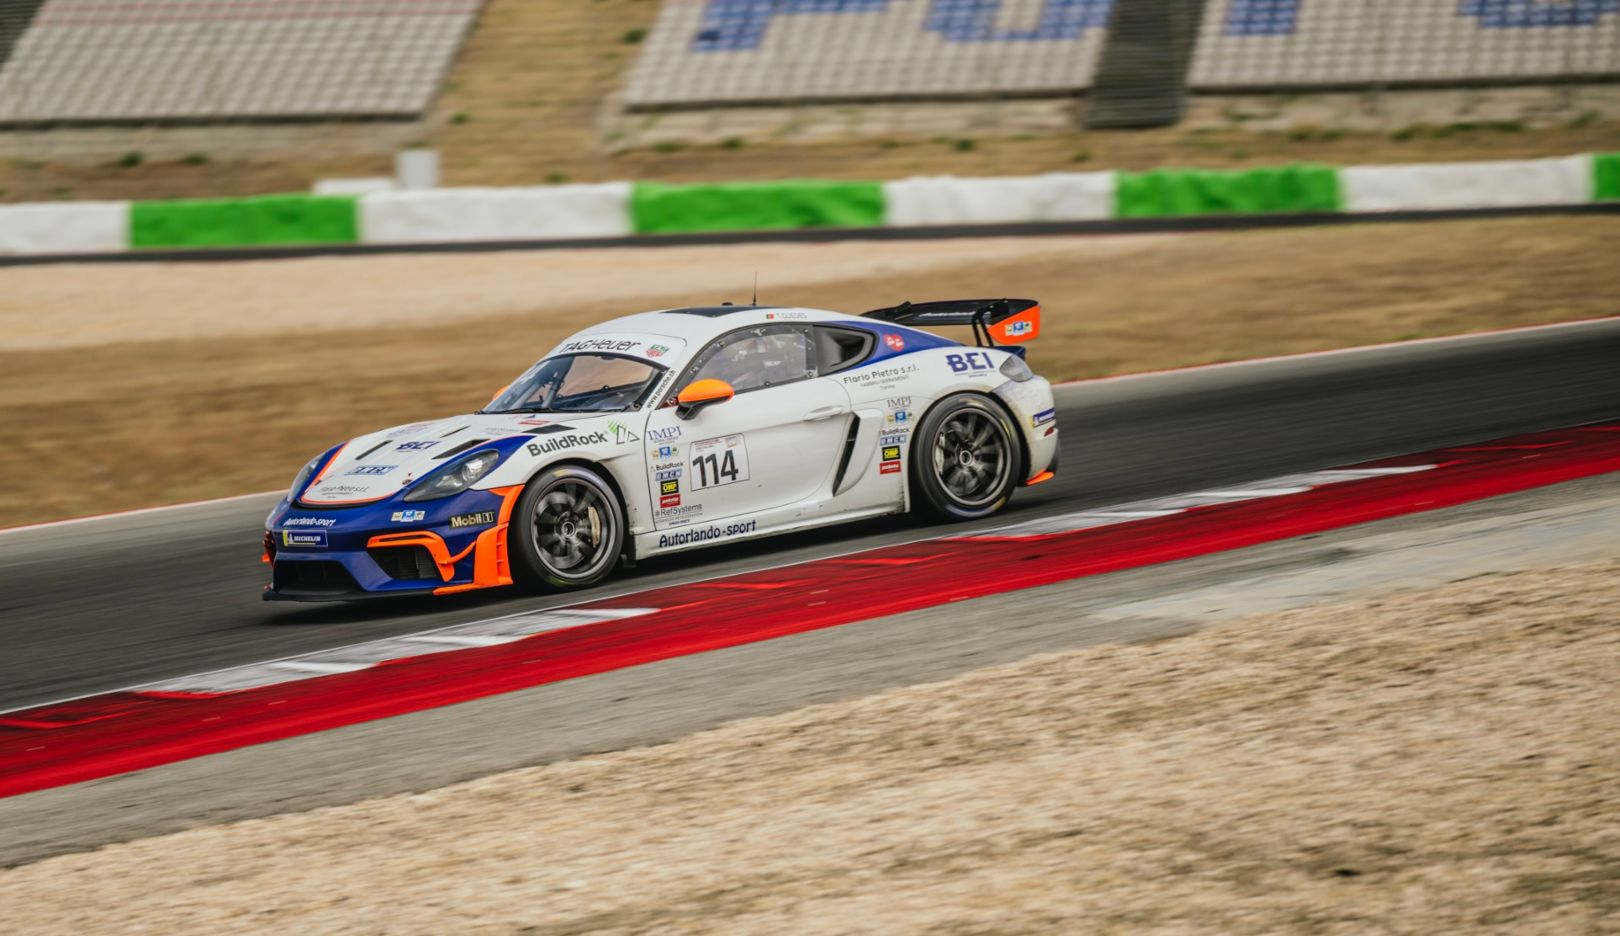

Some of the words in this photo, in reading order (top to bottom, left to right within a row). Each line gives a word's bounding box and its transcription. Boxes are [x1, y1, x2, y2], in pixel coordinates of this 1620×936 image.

[946, 352, 995, 373] BEI
[872, 368, 899, 378] Pietro
[887, 396, 911, 407] IMPI
[648, 426, 681, 440] IMPI
[527, 432, 608, 457] BuildRock
[656, 461, 683, 470] BuildRock
[692, 450, 739, 488] 114
[451, 516, 482, 528] Mobil
